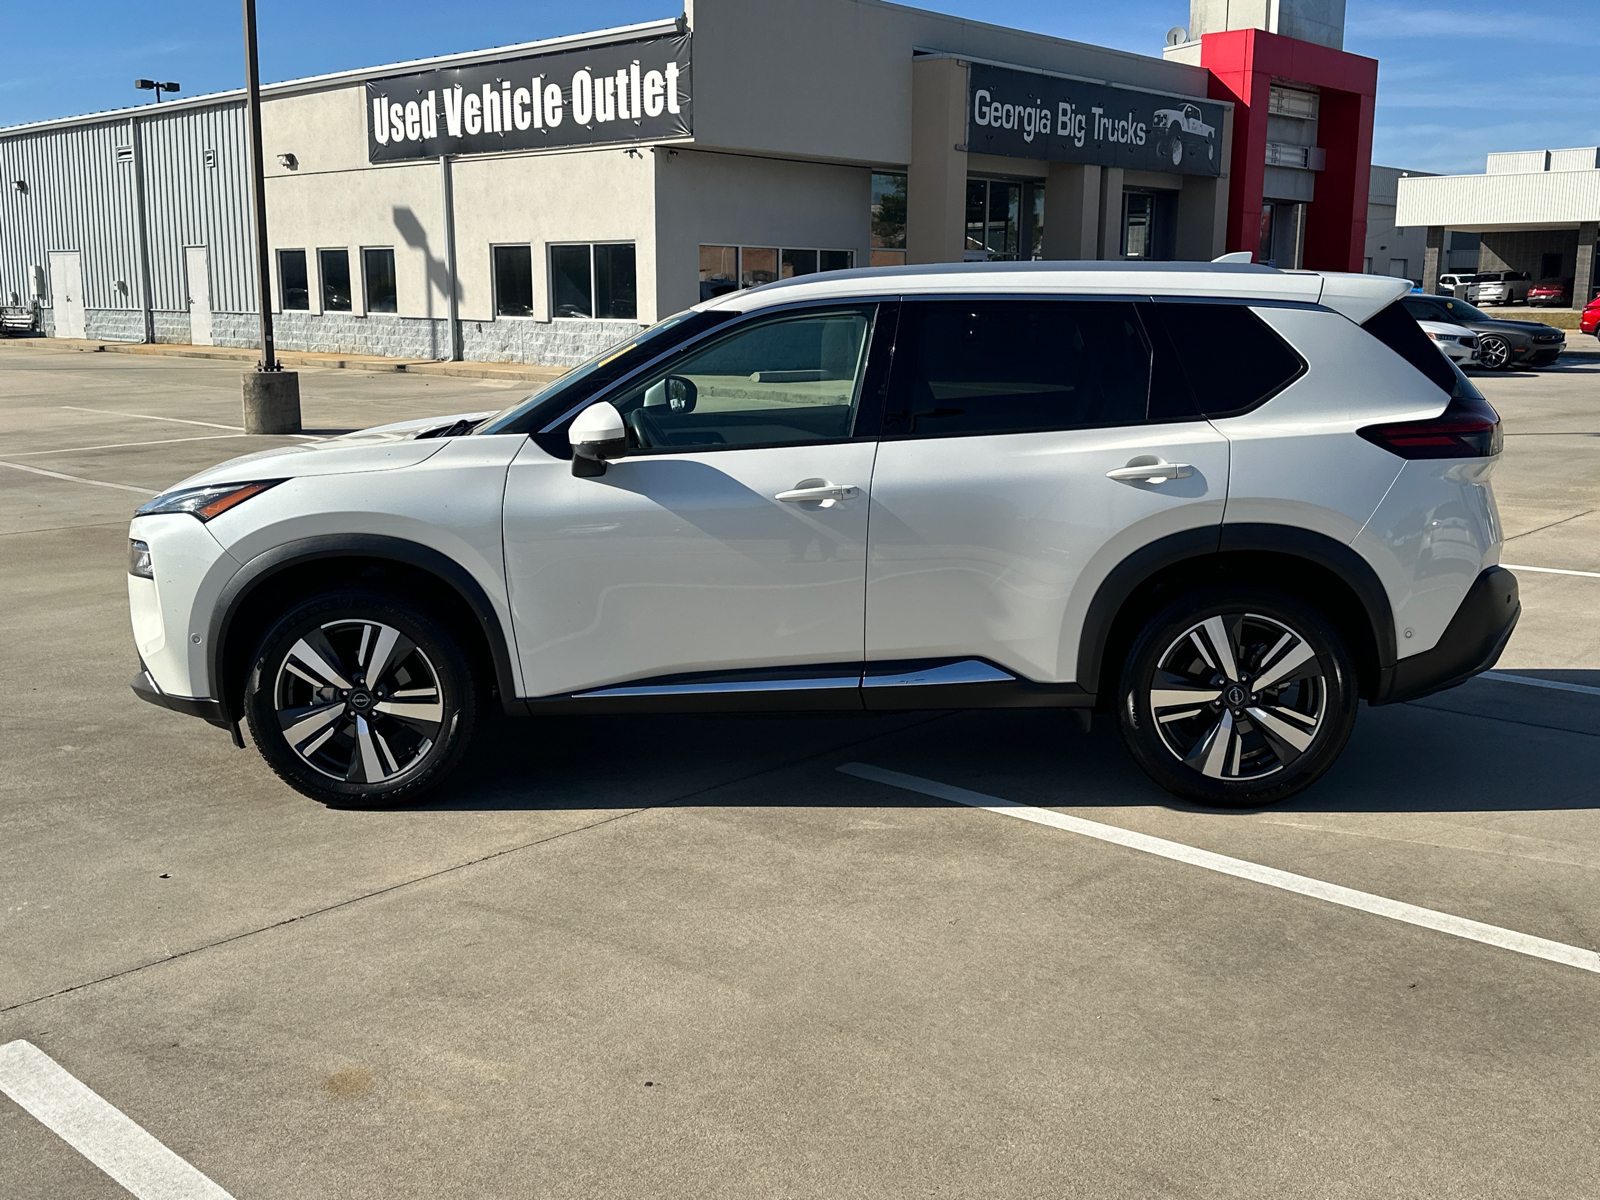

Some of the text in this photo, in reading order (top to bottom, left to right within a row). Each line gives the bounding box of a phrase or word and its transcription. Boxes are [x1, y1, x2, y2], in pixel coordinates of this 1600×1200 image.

[373, 62, 681, 144] Used Vehicle Outlet
[974, 89, 1146, 148] Georgia Big Trucks
